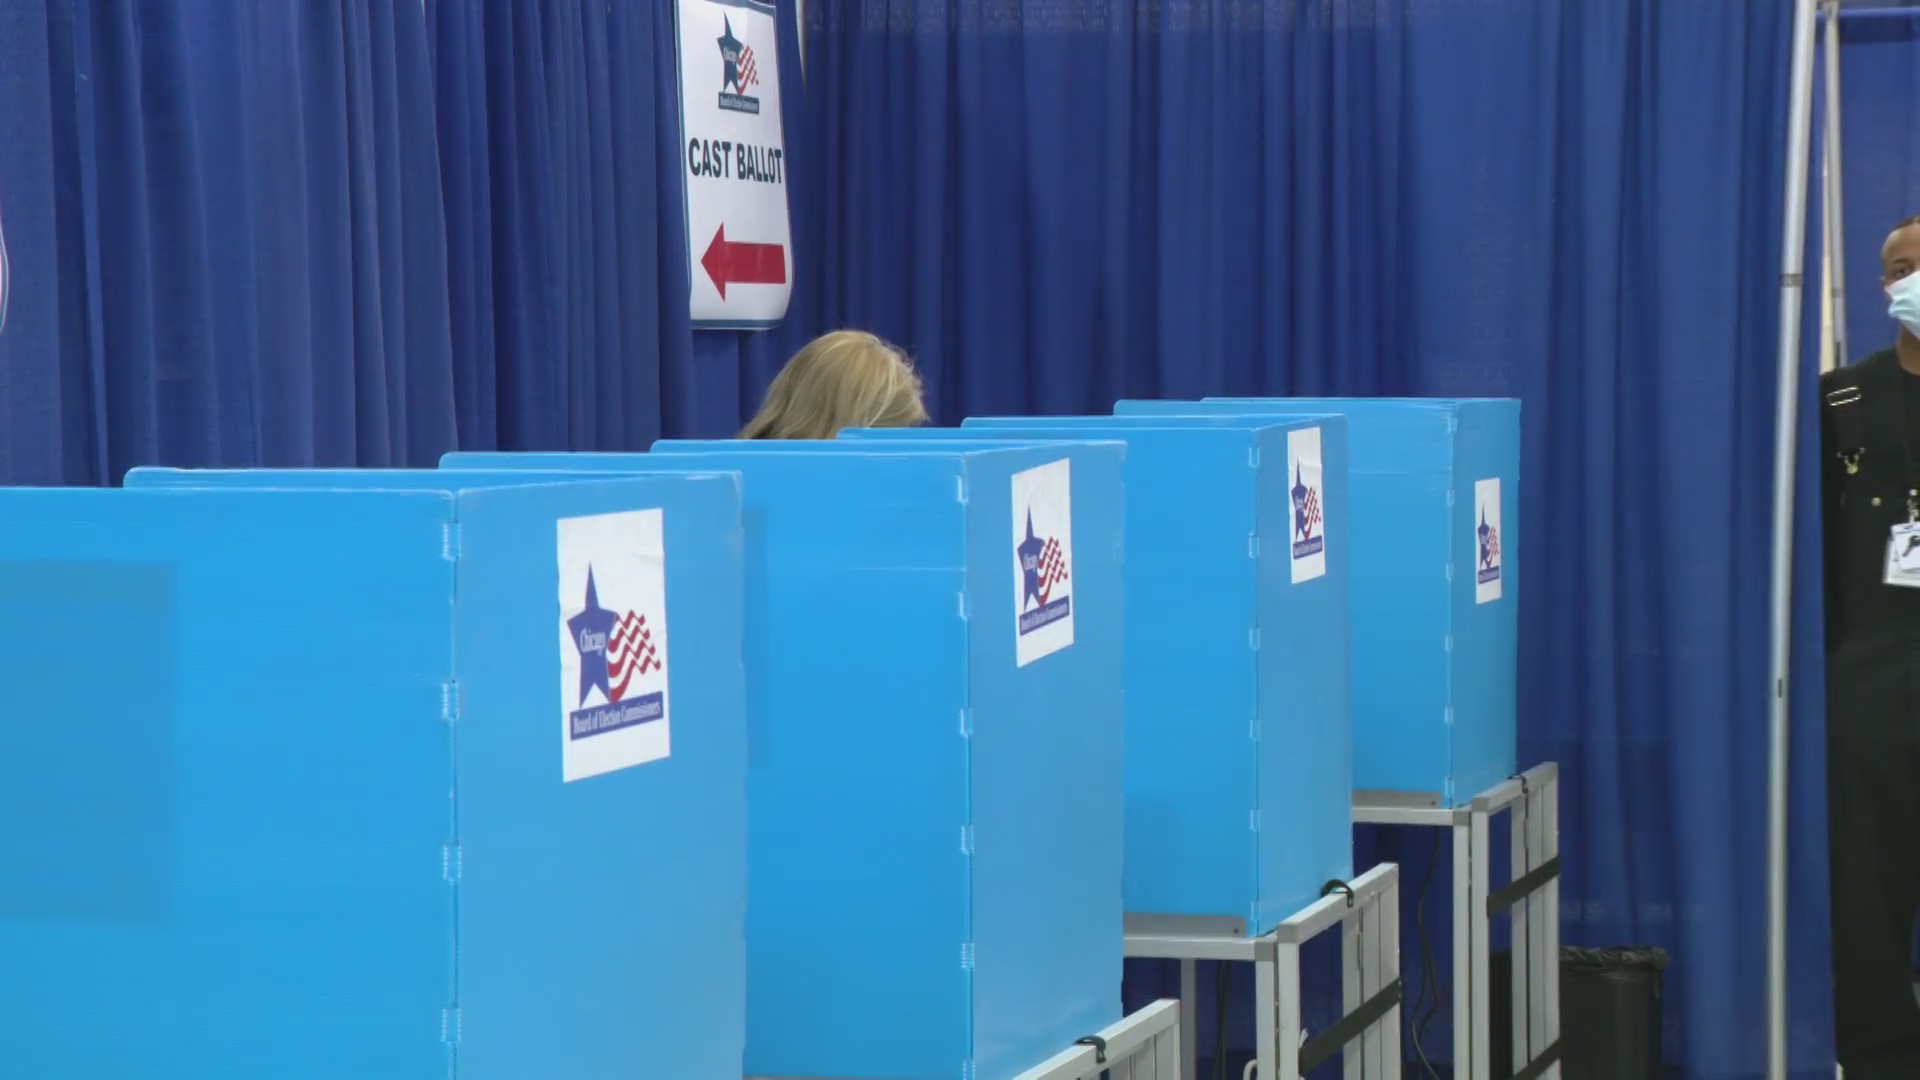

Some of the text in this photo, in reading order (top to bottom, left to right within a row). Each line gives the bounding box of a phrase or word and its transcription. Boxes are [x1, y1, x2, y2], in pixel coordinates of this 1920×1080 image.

[688, 137, 782, 184] CAST BALLOT
[580, 627, 606, 656] Chicago
